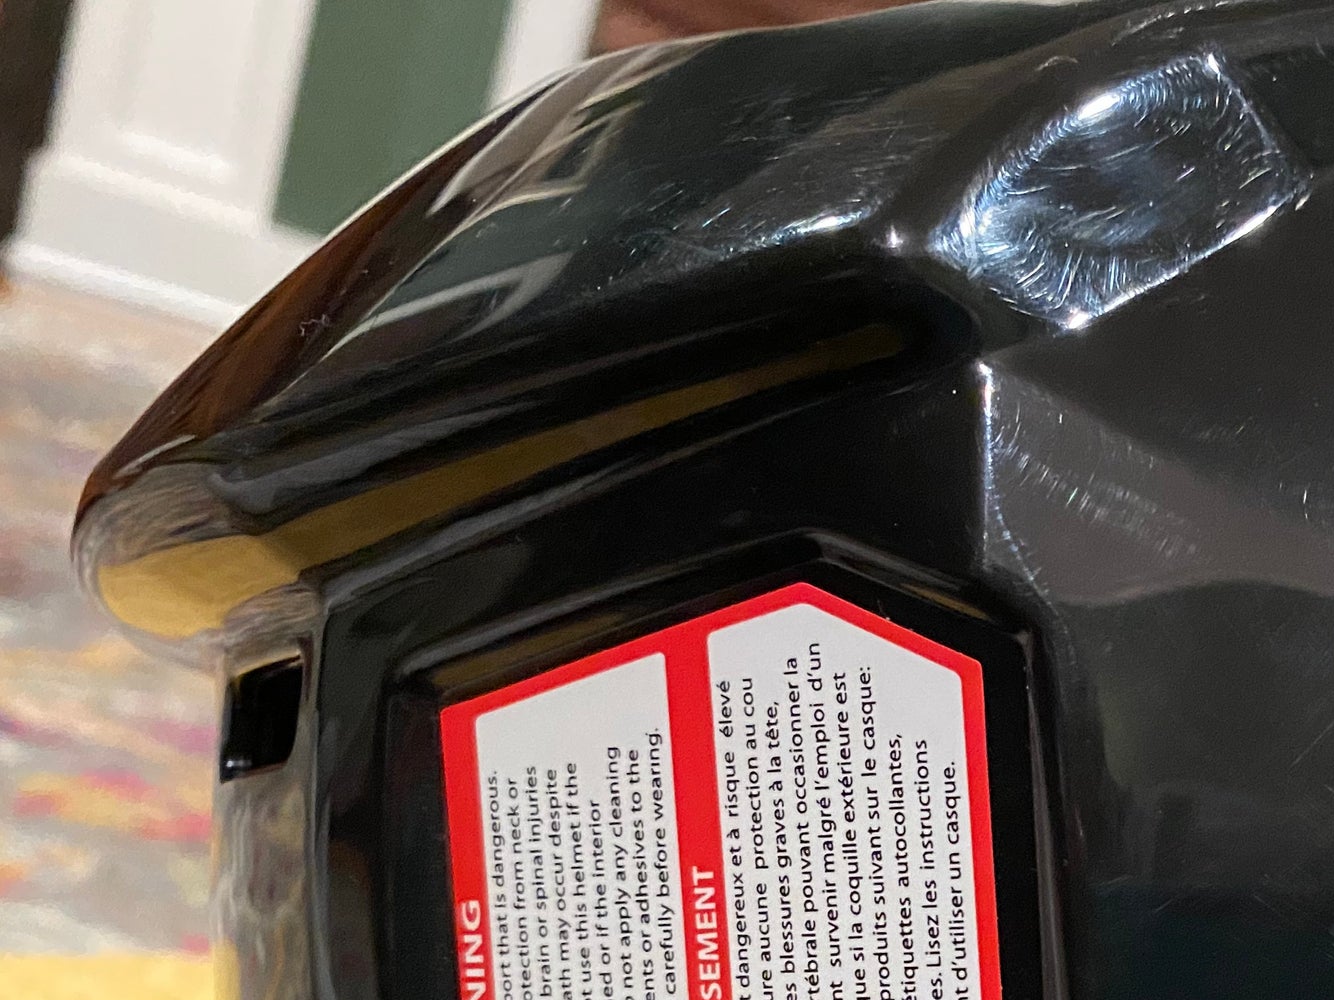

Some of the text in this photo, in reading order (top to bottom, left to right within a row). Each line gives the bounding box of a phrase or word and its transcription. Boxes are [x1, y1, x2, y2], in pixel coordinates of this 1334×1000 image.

[783, 657, 798, 675] la
[806, 643, 823, 692] d'un
[833, 672, 848, 705] est
[716, 680, 734, 738] élevé
[742, 678, 755, 717] cou
[764, 701, 780, 750] tête,
[859, 666, 877, 751] casque:
[745, 724, 757, 750] au
[766, 756, 782, 773] la
[787, 681, 808, 814] occasionner
[809, 703, 831, 791] l'emploi
[564, 763, 578, 798] the
[606, 747, 623, 838] cleaning
[626, 749, 641, 785] the
[645, 728, 664, 822] wearing.
[724, 752, 740, 817] risque
[836, 711, 856, 823] extérieure
[860, 758, 877, 777] le
[488, 771, 505, 887] dangerous.
[506, 805, 522, 854] neck
[525, 766, 544, 842] injuries
[545, 769, 563, 847] despite
[630, 791, 643, 813] to
[745, 756, 769, 869] protection
[866, 786, 880, 820] sur
[888, 734, 910, 888] autocollantes,
[914, 739, 935, 870] instructions
[943, 761, 961, 845] casque.
[569, 821, 586, 896] helmet
[588, 800, 605, 877] interior
[613, 844, 629, 881] any
[653, 828, 670, 897] before
[729, 845, 742, 867] et
[773, 798, 792, 869] graves
[816, 797, 837, 873] malgré
[513, 861, 526, 910] from
[529, 849, 549, 910] spinal
[552, 853, 566, 911] occur
[632, 819, 651, 924] adhesives
[796, 821, 819, 913] pouvant
[841, 829, 864, 916] coquille
[867, 826, 886, 905] suivant
[921, 880, 938, 909] les
[948, 852, 962, 880] un
[574, 903, 589, 941] this
[594, 884, 608, 919] the
[614, 888, 633, 947] apply
[732, 873, 752, 988] dangereux
[756, 883, 772, 962] aucune
[778, 874, 796, 974] blessures
[821, 879, 842, 968] survenir
[496, 914, 510, 957] that
[557, 917, 572, 961] may
[600, 943, 611, 965] or
[640, 930, 653, 953] or
[657, 903, 677, 995] carefully
[847, 922, 864, 940] la
[924, 914, 942, 967] Lisez
[948, 886, 968, 981] d'utiliser
[537, 944, 552, 997] brain
[580, 947, 592, 983] use
[620, 953, 634, 989] not
